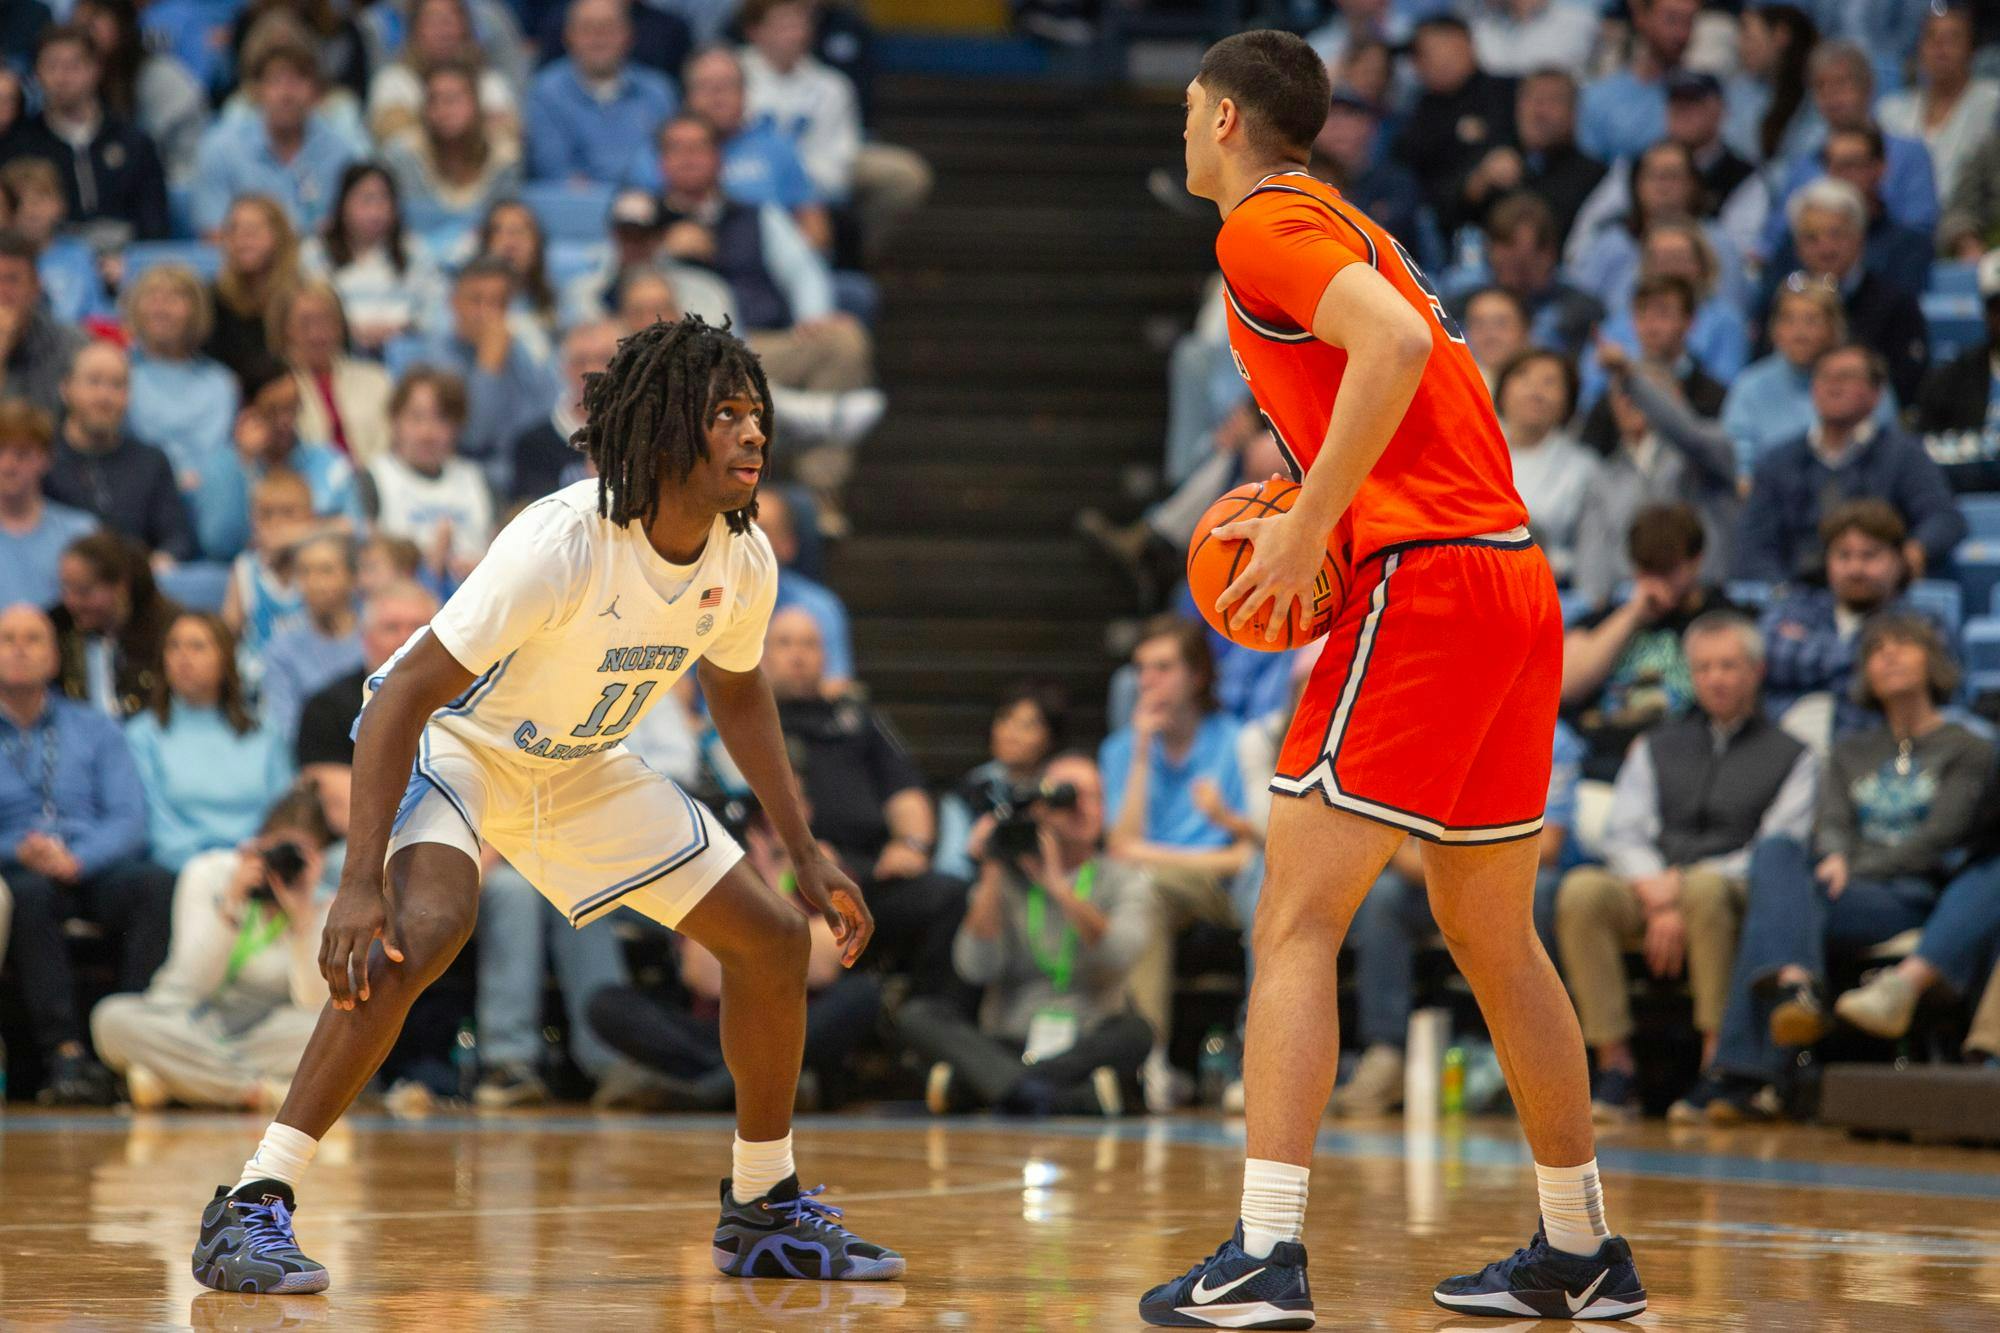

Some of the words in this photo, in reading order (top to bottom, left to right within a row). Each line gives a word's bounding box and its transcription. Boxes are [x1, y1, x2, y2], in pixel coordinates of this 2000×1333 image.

[597, 645, 689, 673] NORTH
[570, 681, 658, 738] 11
[513, 720, 629, 760] CAROL
